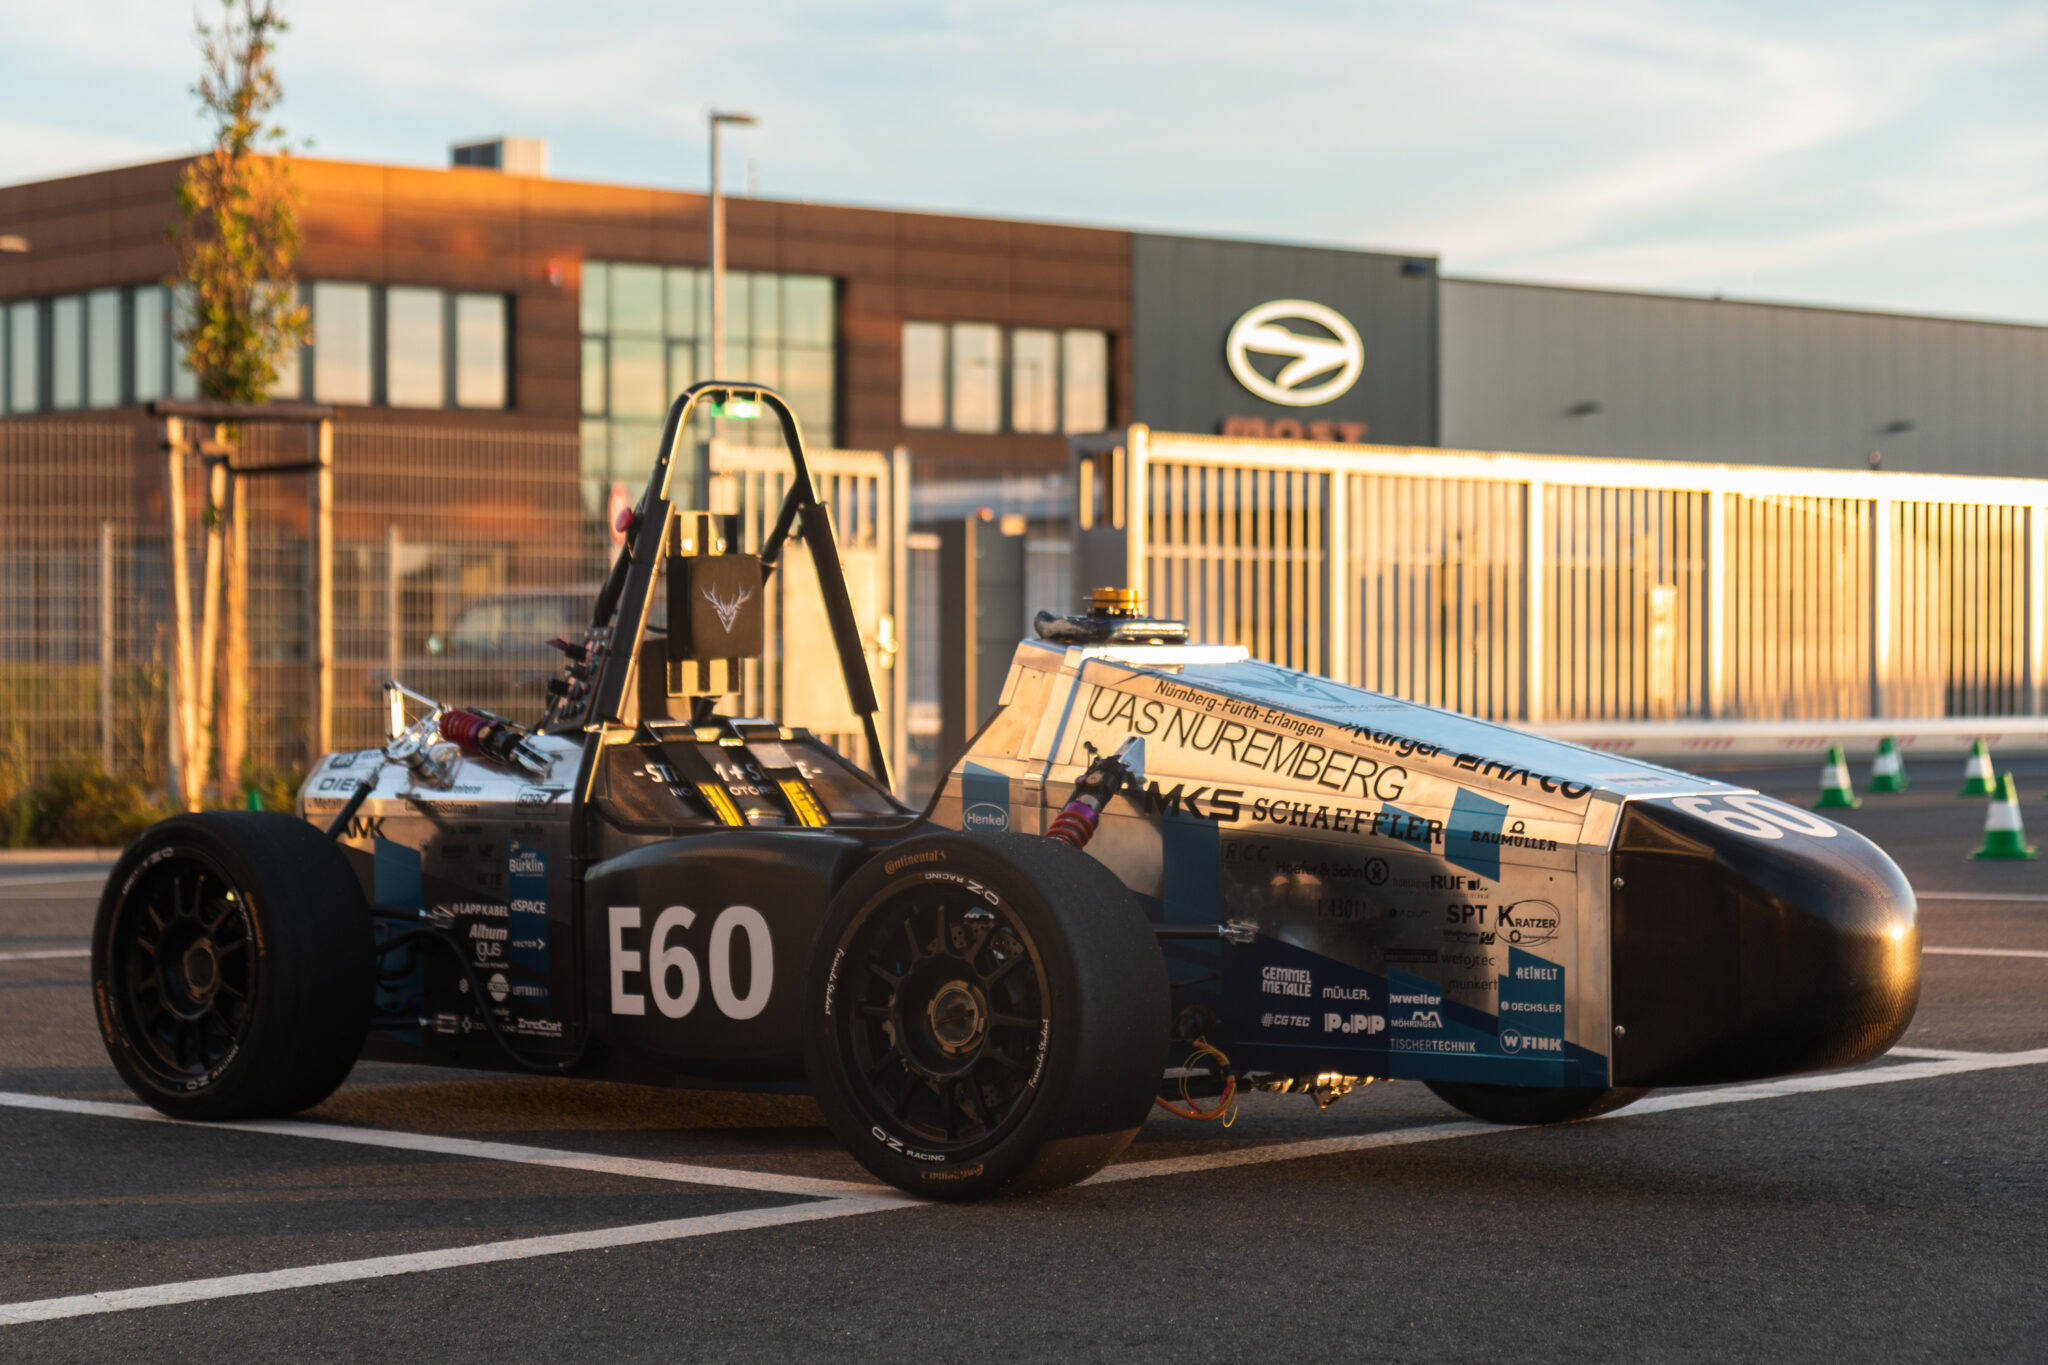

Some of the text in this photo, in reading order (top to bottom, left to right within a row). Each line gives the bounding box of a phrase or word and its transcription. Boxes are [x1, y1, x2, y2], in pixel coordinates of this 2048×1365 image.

[1154, 680, 1325, 739] Nürnberg-Fürth-Erlangen
[1087, 686, 1408, 801] UAS NUREMBERG
[967, 812, 1006, 826] Henkel
[1251, 796, 1443, 845] SCHAEFFLER
[1671, 797, 1839, 840] 60
[508, 857, 545, 873] Bürklin
[924, 873, 965, 884] RACING
[510, 899, 546, 914] dSPACE
[1446, 904, 1488, 924] SPT
[1498, 904, 1557, 929] KRATZER
[608, 905, 774, 1020] E60
[1261, 965, 1312, 983] GEMMEL
[1261, 979, 1312, 998] METALLE
[1511, 1001, 1562, 1013] OECHSLER
[1389, 1037, 1477, 1053] TISCHERTECHNIK
[1522, 1036, 1562, 1052] FINK
[906, 1149, 946, 1162] RACING
